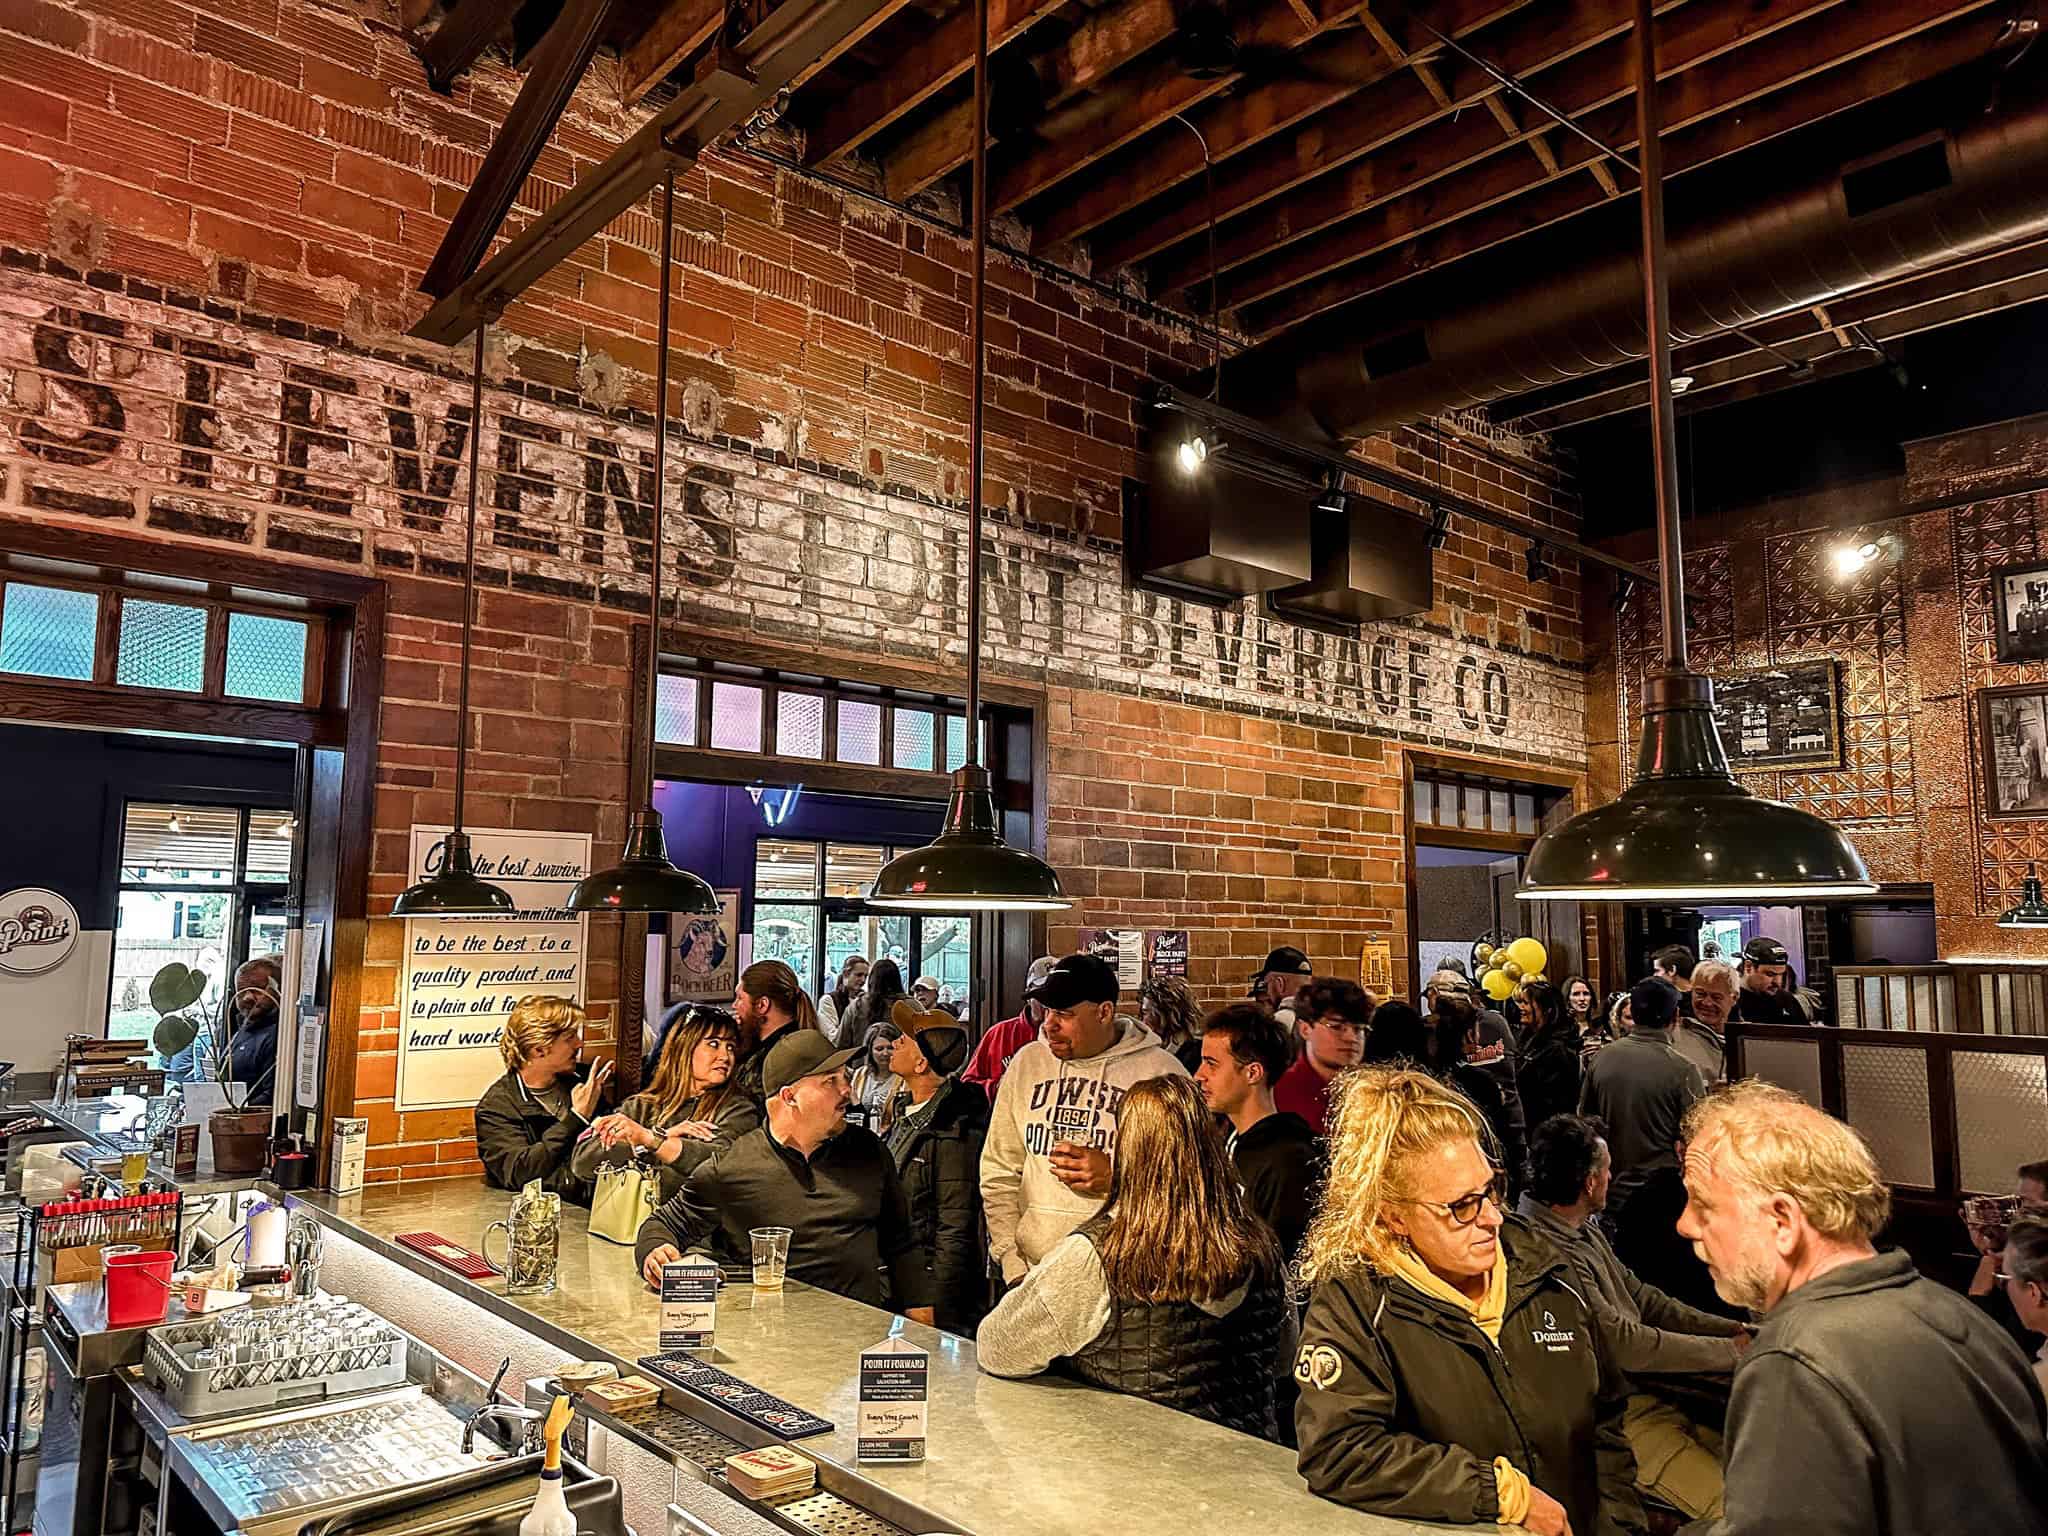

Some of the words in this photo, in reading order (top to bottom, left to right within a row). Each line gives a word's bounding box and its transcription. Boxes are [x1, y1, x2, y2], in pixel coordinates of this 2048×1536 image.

[18, 304, 736, 588] STEVENS
[802, 490, 1080, 656] POINT
[1121, 588, 1434, 723] BEVERAGE
[1455, 655, 1508, 736] CO
[473, 854, 495, 875] the
[498, 855, 530, 876] best
[0, 917, 70, 955] Point
[415, 936, 430, 951] to
[436, 935, 456, 951] be
[462, 935, 487, 951] the
[540, 935, 555, 951] to
[561, 939, 571, 951] a
[1156, 934, 1178, 950] Point
[1171, 950, 1186, 958] PARTY
[412, 966, 471, 991] quality
[546, 964, 576, 981] and
[703, 972, 732, 993] BEER
[412, 999, 426, 1015] to
[427, 997, 466, 1019] plain
[470, 996, 495, 1012] old
[409, 1029, 453, 1047] hard
[458, 1027, 502, 1045] work
[1056, 1109, 1089, 1125] 1894
[1532, 1330, 1575, 1343] Domtar
[863, 1359, 883, 1369] POUR
[883, 1359, 890, 1369] IT
[890, 1359, 925, 1369] FORWARD
